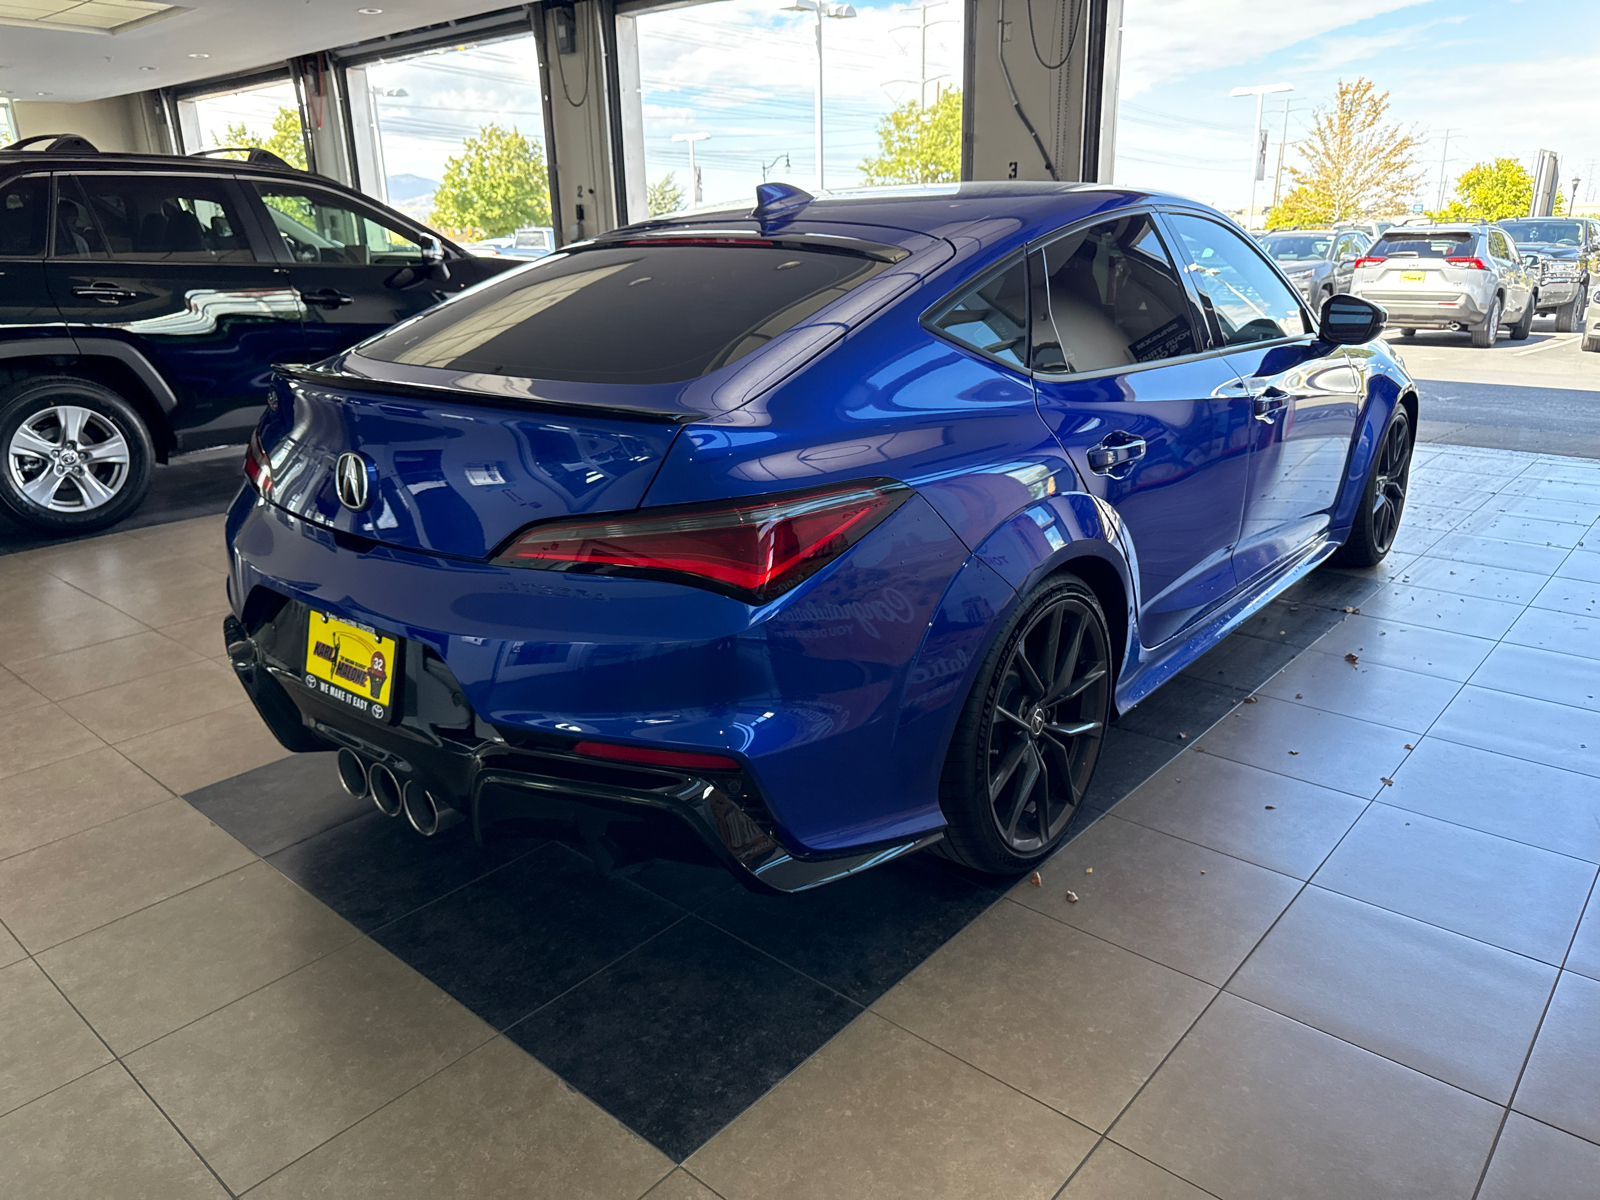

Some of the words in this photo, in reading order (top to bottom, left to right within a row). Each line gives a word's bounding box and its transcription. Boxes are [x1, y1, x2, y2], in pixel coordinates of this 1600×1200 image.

[1008, 161, 1018, 180] 3
[576, 184, 585, 198] 2
[313, 640, 335, 662] KARL
[335, 661, 368, 688] MALONE
[373, 657, 383, 671] 32
[319, 680, 329, 694] WE
[330, 685, 345, 702] MAKE
[345, 691, 352, 704] IT
[353, 695, 368, 711] EASY
[976, 687, 996, 771] MICHELIN
